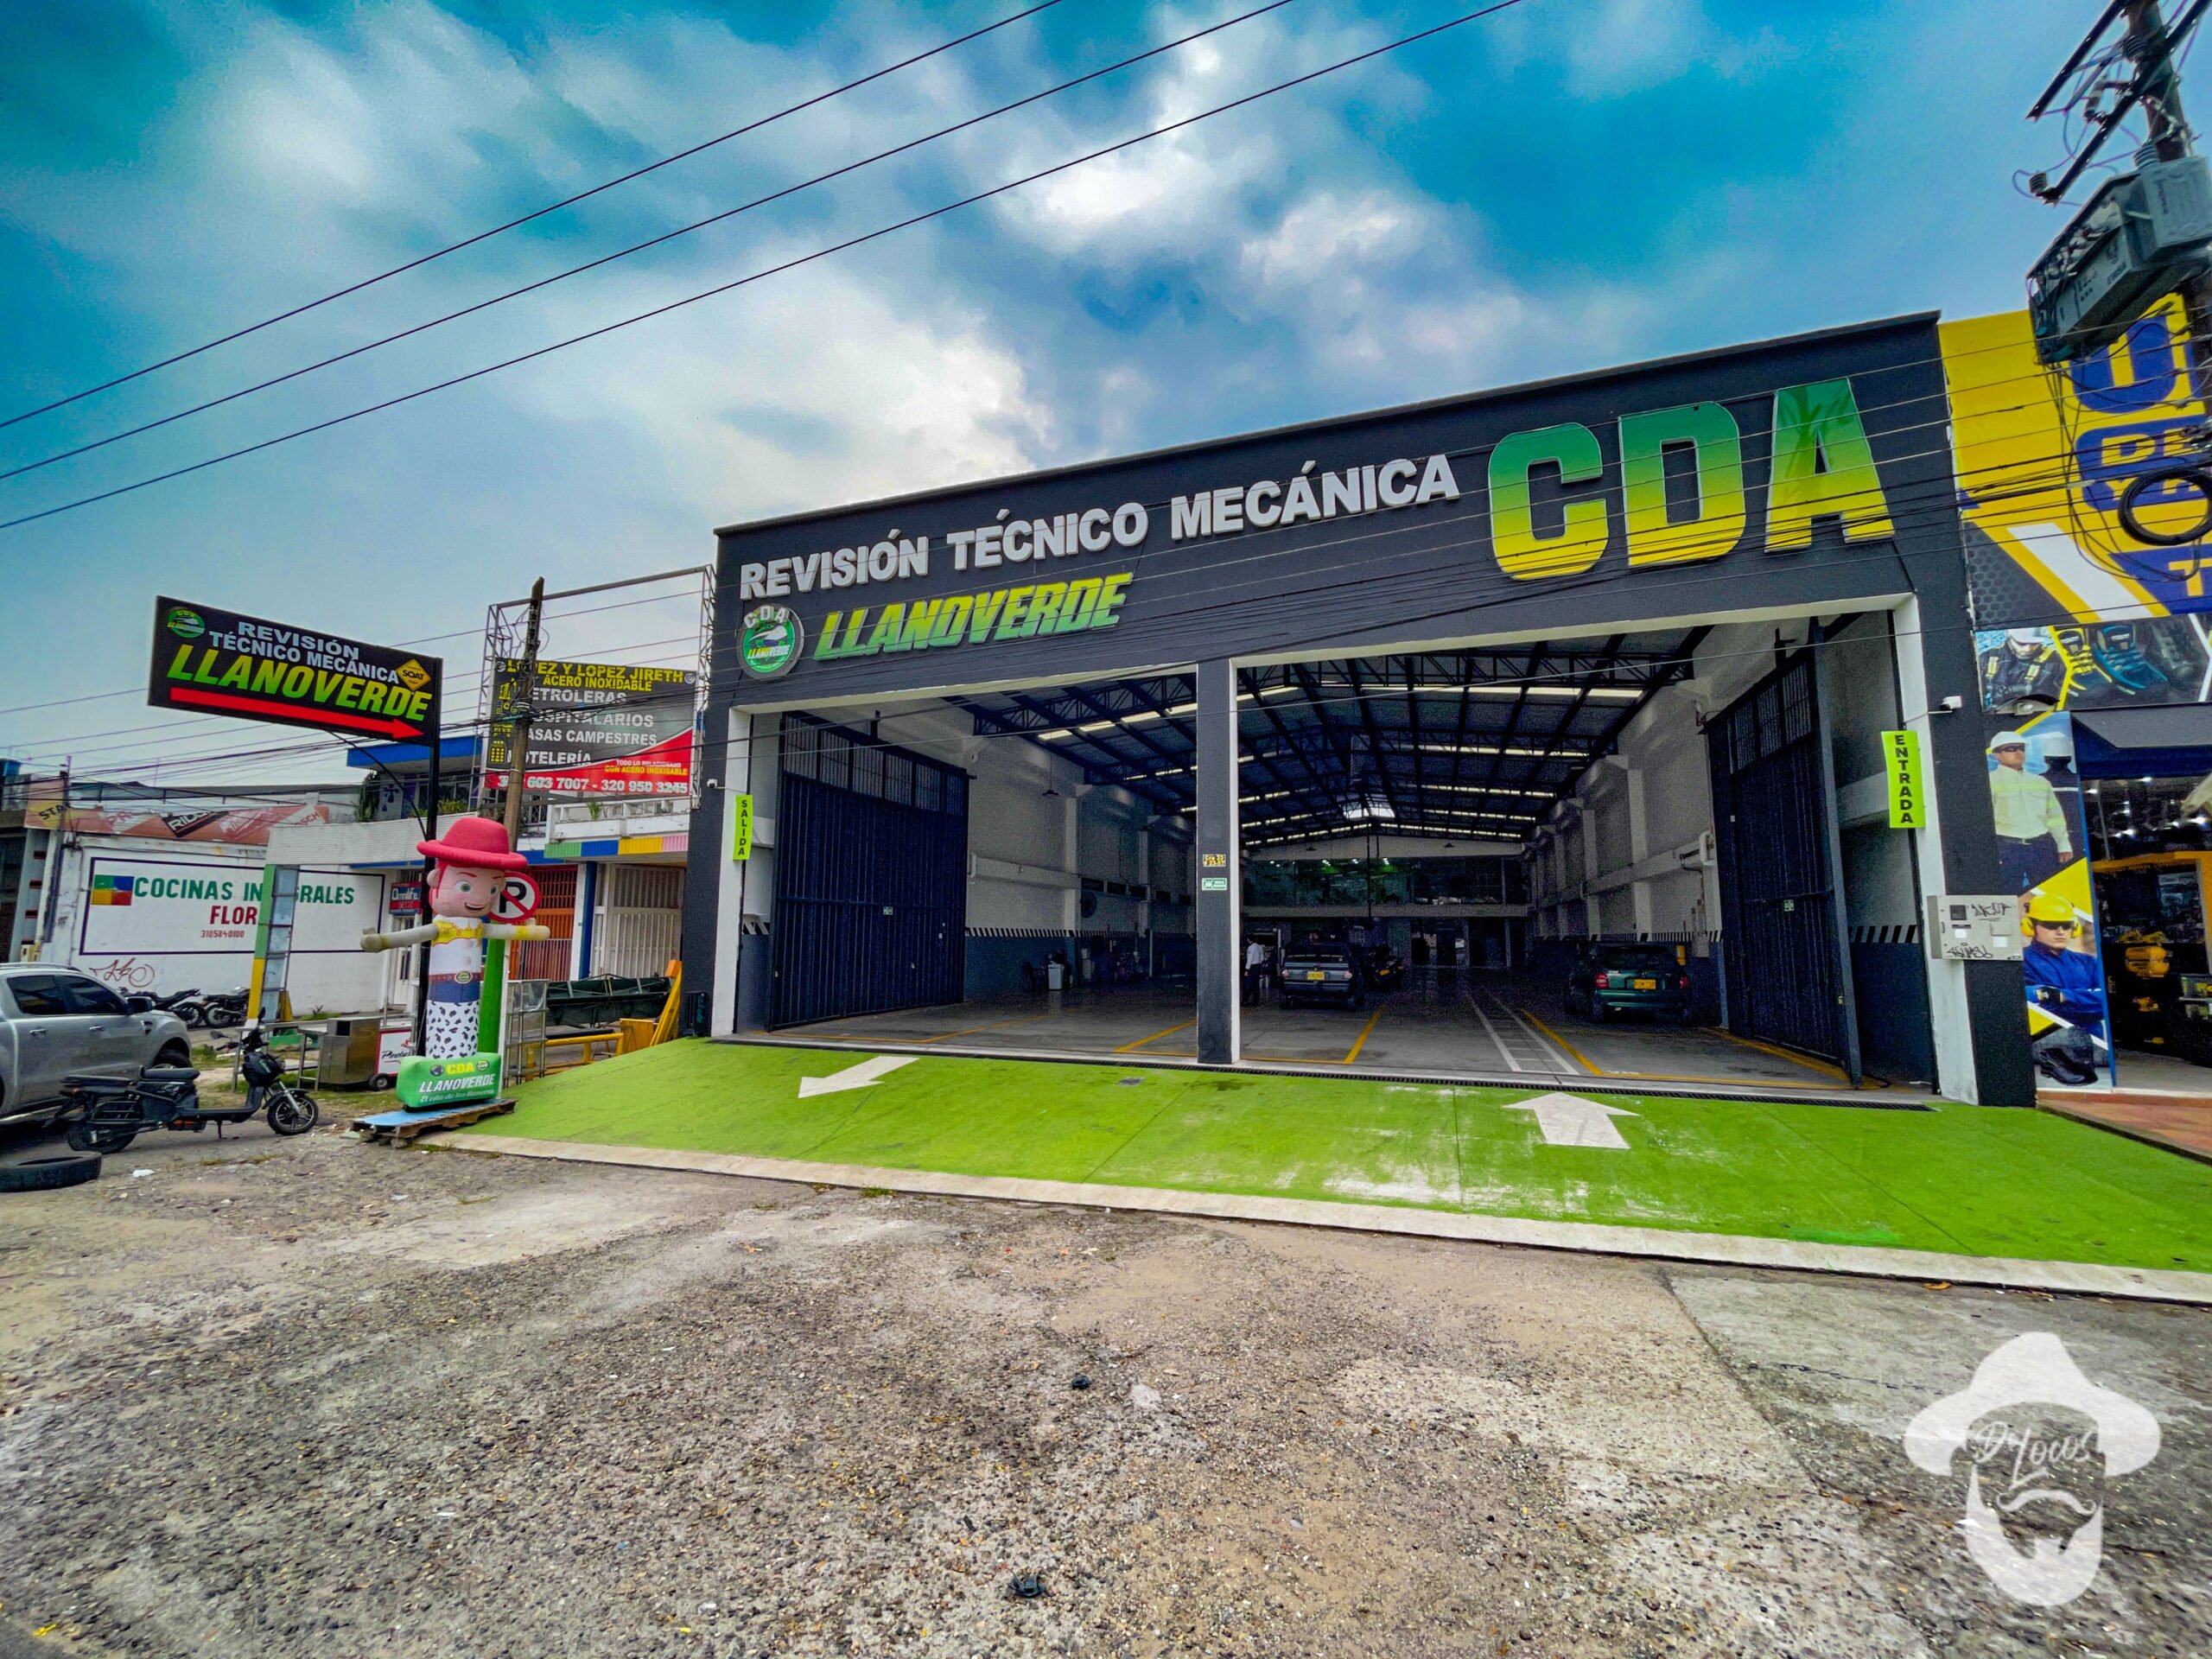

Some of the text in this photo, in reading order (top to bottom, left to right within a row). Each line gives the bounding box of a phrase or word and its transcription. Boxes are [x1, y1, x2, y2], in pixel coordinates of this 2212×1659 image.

[1487, 377, 1897, 581] CDA
[740, 454, 1461, 601] REVISIÓN TÉCNICO MECÁNICA
[744, 605, 790, 629] CDA
[812, 571, 1135, 661] LLANOVERDE
[238, 620, 359, 660] REVISIÓN
[208, 631, 399, 684] TÉCNICO MECÁNICA
[166, 644, 433, 721] LLANOVERDE
[402, 669, 425, 681] SOAT
[507, 659, 683, 683] LEZ Y LOPEZ JIRETH
[532, 687, 627, 703] ETROLERAS
[585, 676, 652, 692] INOXIDABLE
[528, 728, 563, 741] ASAS
[566, 729, 658, 746] CAMPESTRES
[601, 779, 626, 791] 320
[1894, 734, 1914, 823] ENTRADA
[738, 799, 748, 855] SALIDA
[133, 876, 233, 901] COCINAS
[446, 1062, 475, 1075] CDA
[419, 1073, 496, 1093] LLANOVERDE
